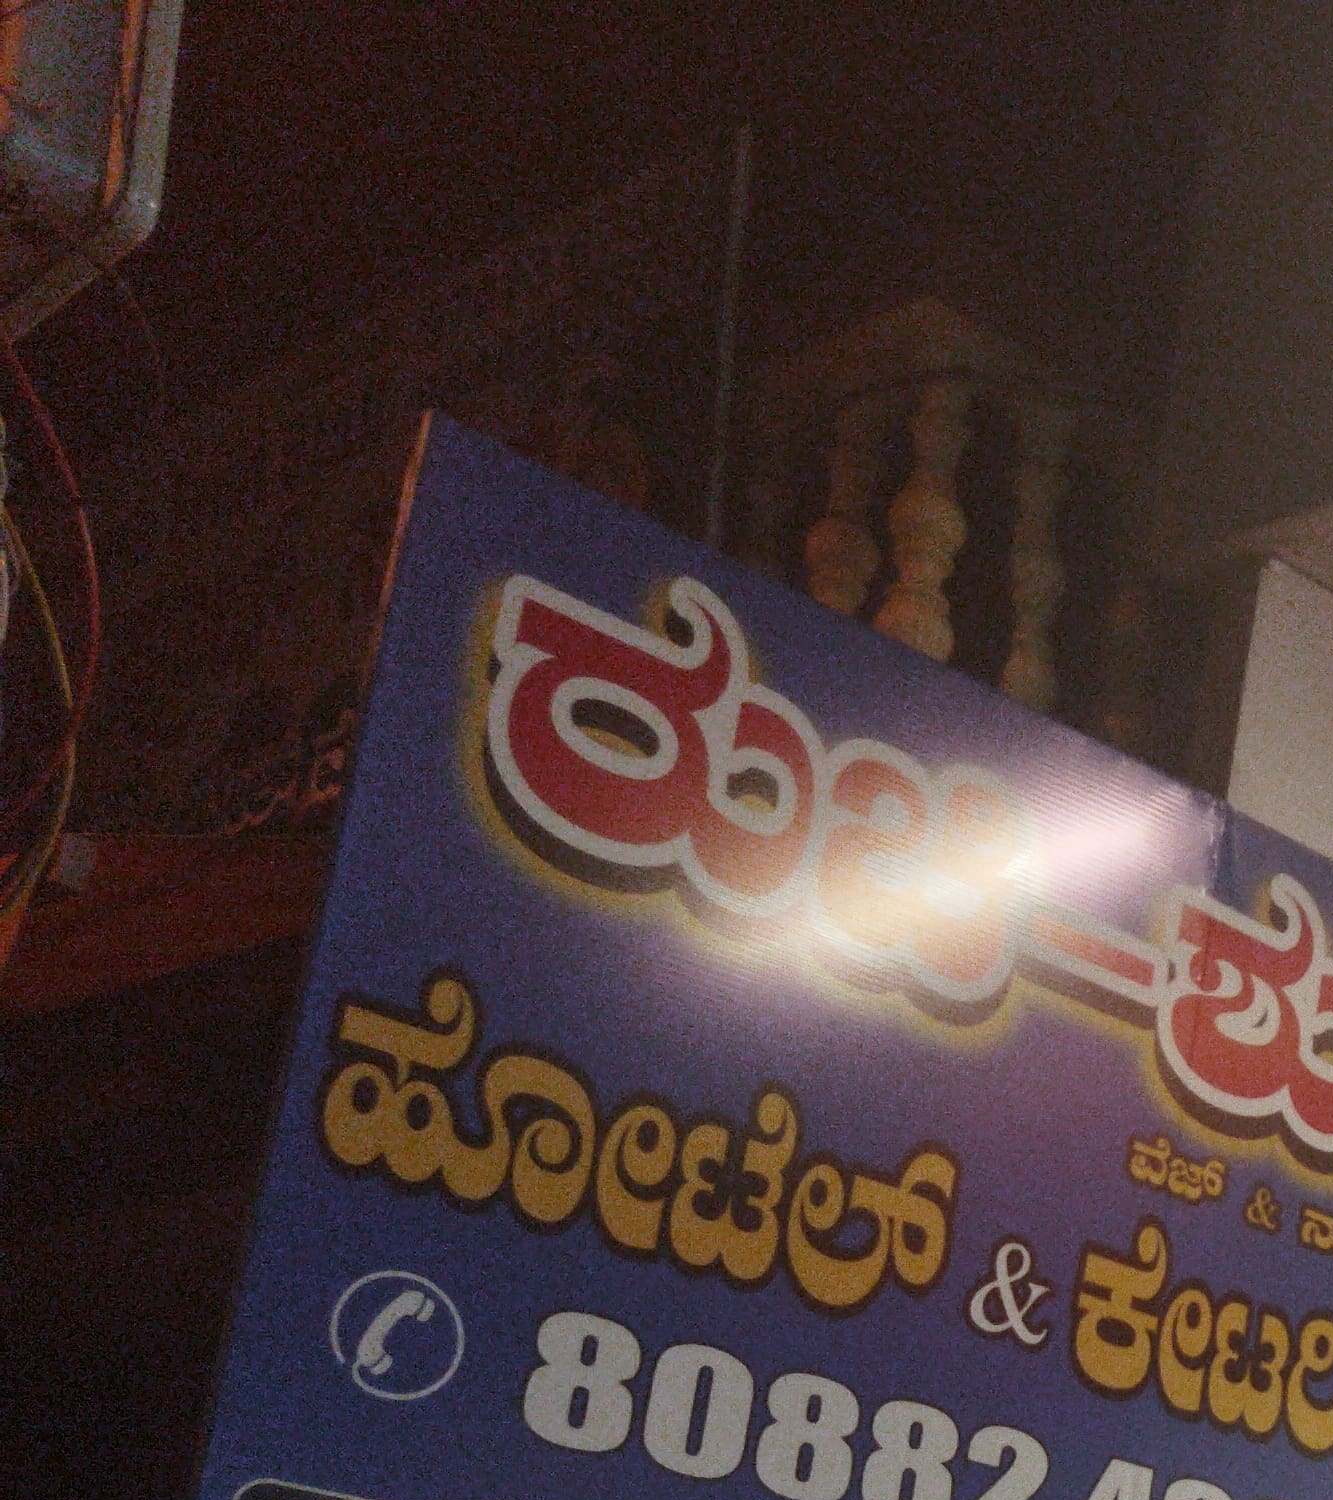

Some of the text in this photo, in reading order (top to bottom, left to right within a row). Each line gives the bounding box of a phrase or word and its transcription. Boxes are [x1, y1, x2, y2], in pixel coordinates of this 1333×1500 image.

[322, 977, 957, 1310] ಹೋಟೆಲ್
[968, 1243, 1053, 1347] &
[1129, 1136, 1226, 1201] ವೆಜ್
[1246, 1185, 1281, 1232] &
